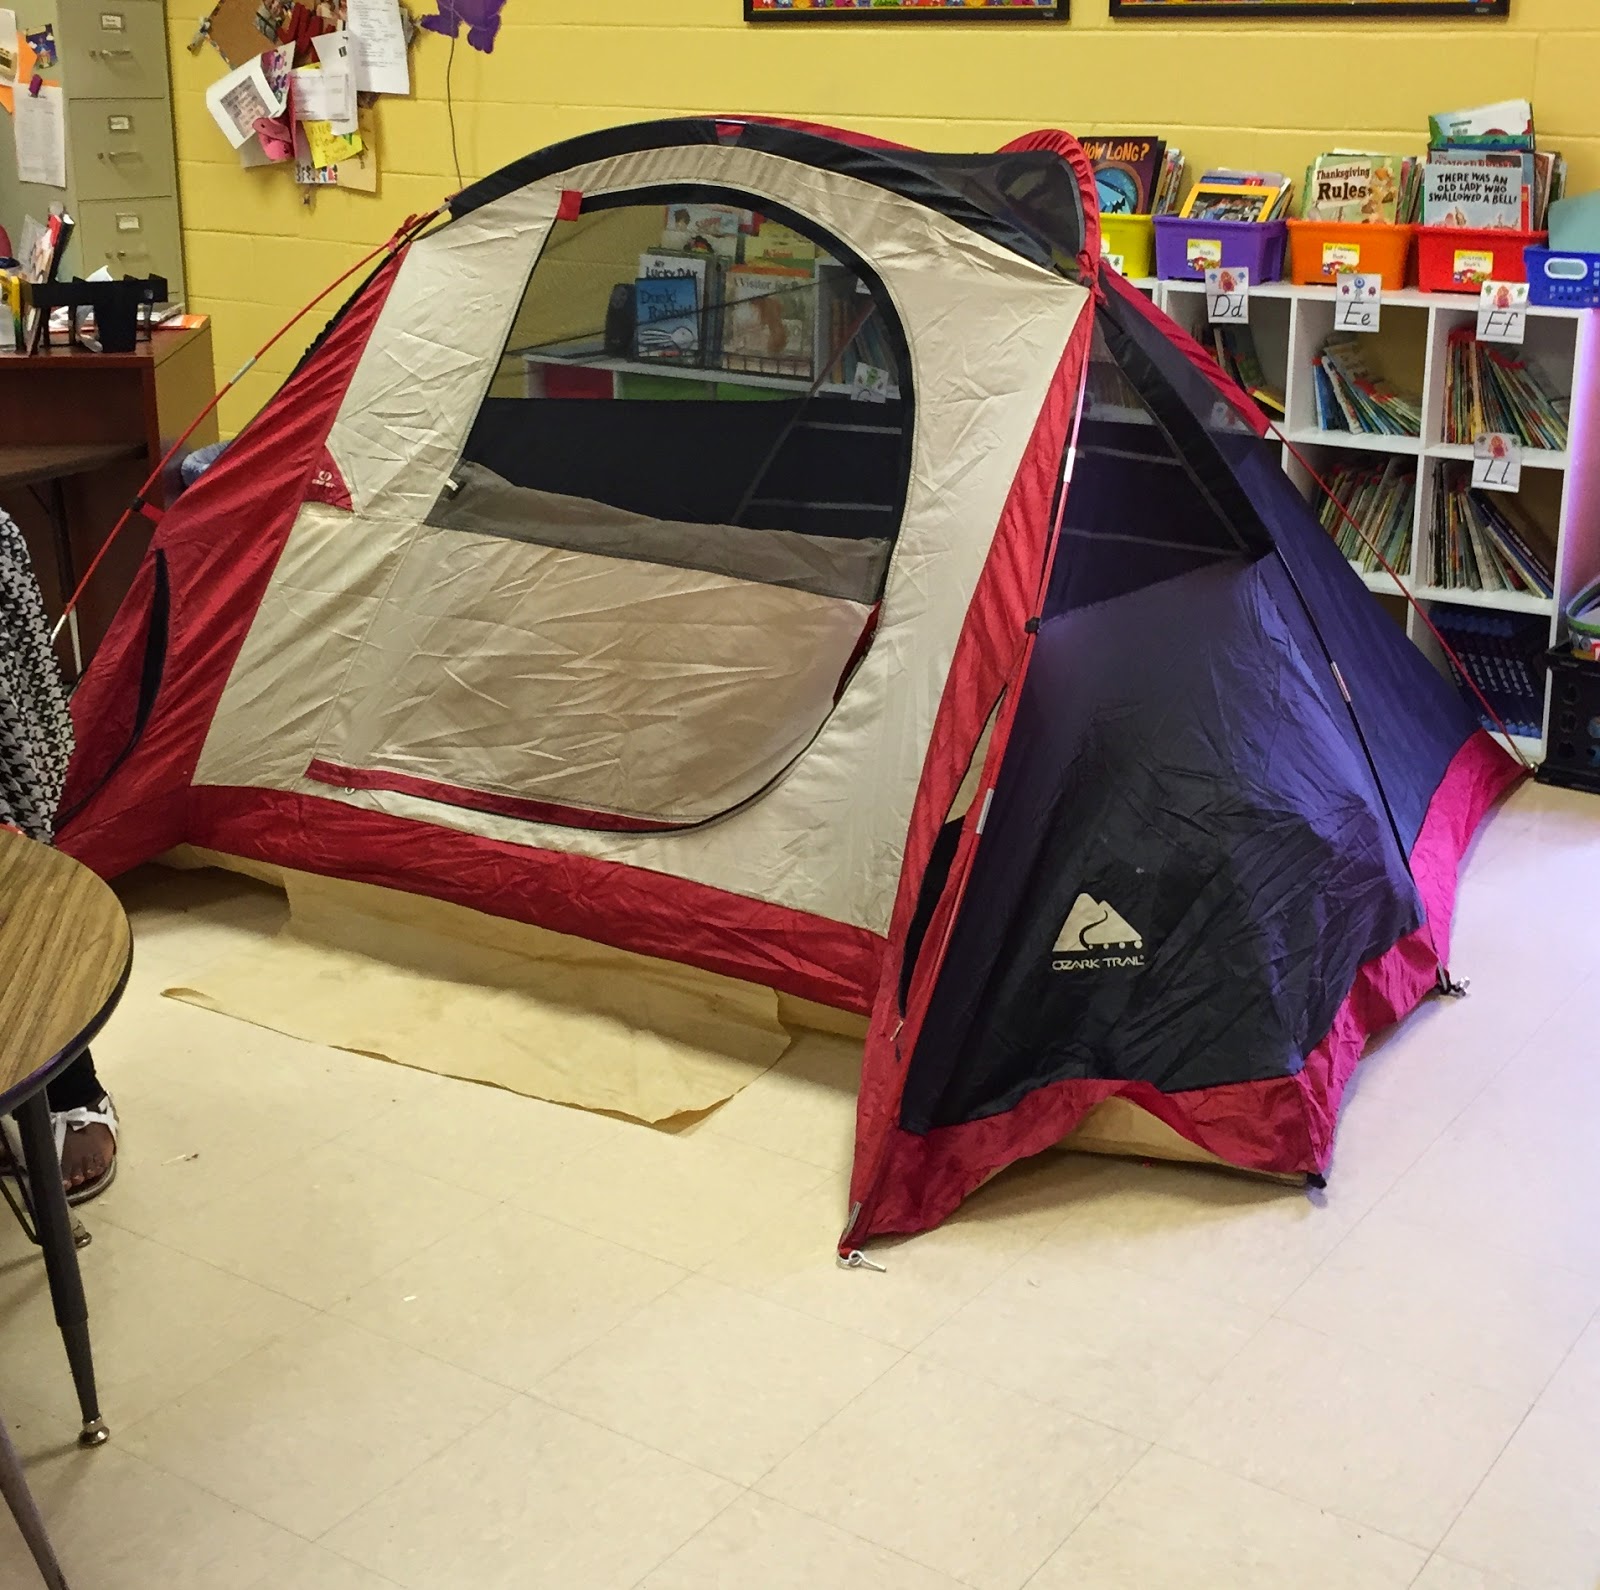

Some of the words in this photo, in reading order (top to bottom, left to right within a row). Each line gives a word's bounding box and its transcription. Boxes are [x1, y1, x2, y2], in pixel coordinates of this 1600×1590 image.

[1083, 141, 1106, 160] HOW
[1106, 141, 1150, 161] LONG?
[1317, 166, 1370, 180] Thanksgiving
[1437, 173, 1469, 183] THERE
[1472, 172, 1490, 183] WAS
[1493, 174, 1508, 185] AN
[1317, 182, 1367, 200] Rules
[1437, 183, 1456, 192] OLD
[1460, 182, 1482, 192] LADY
[1484, 185, 1507, 193] WHO
[1428, 192, 1482, 202] SWALLOWED
[1492, 195, 1517, 205] BELL!
[1212, 294, 1243, 317] Dd
[1344, 301, 1371, 326] Ee
[1483, 311, 1518, 336] Ff
[1483, 460, 1510, 485] Ll
[1052, 958, 1100, 971] OZARK
